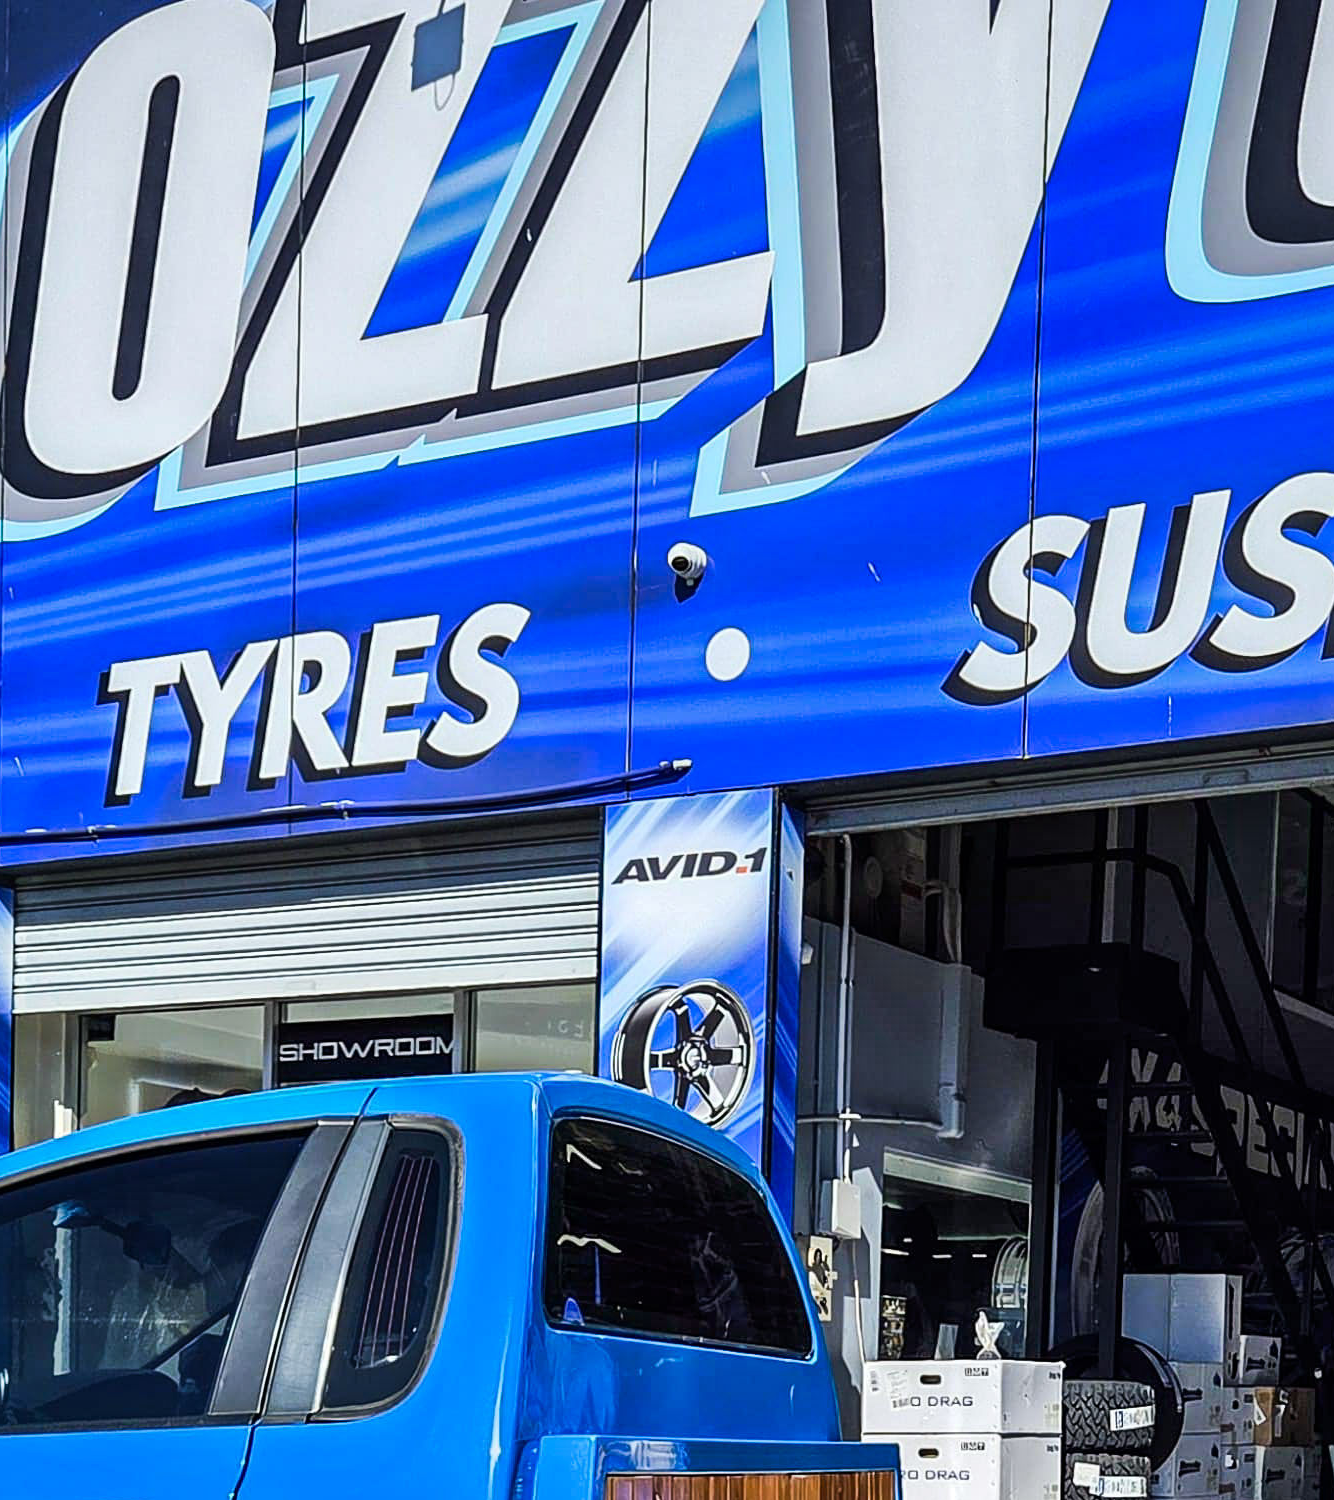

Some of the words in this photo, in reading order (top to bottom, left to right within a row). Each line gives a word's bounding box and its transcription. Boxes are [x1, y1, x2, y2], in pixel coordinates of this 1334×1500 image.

[105, 602, 532, 799] TYRES
[611, 846, 768, 885] AVID.1
[279, 1037, 454, 1063] SHOWROOM
[927, 1396, 974, 1407] DRAG
[925, 1469, 970, 1481] DRAG
